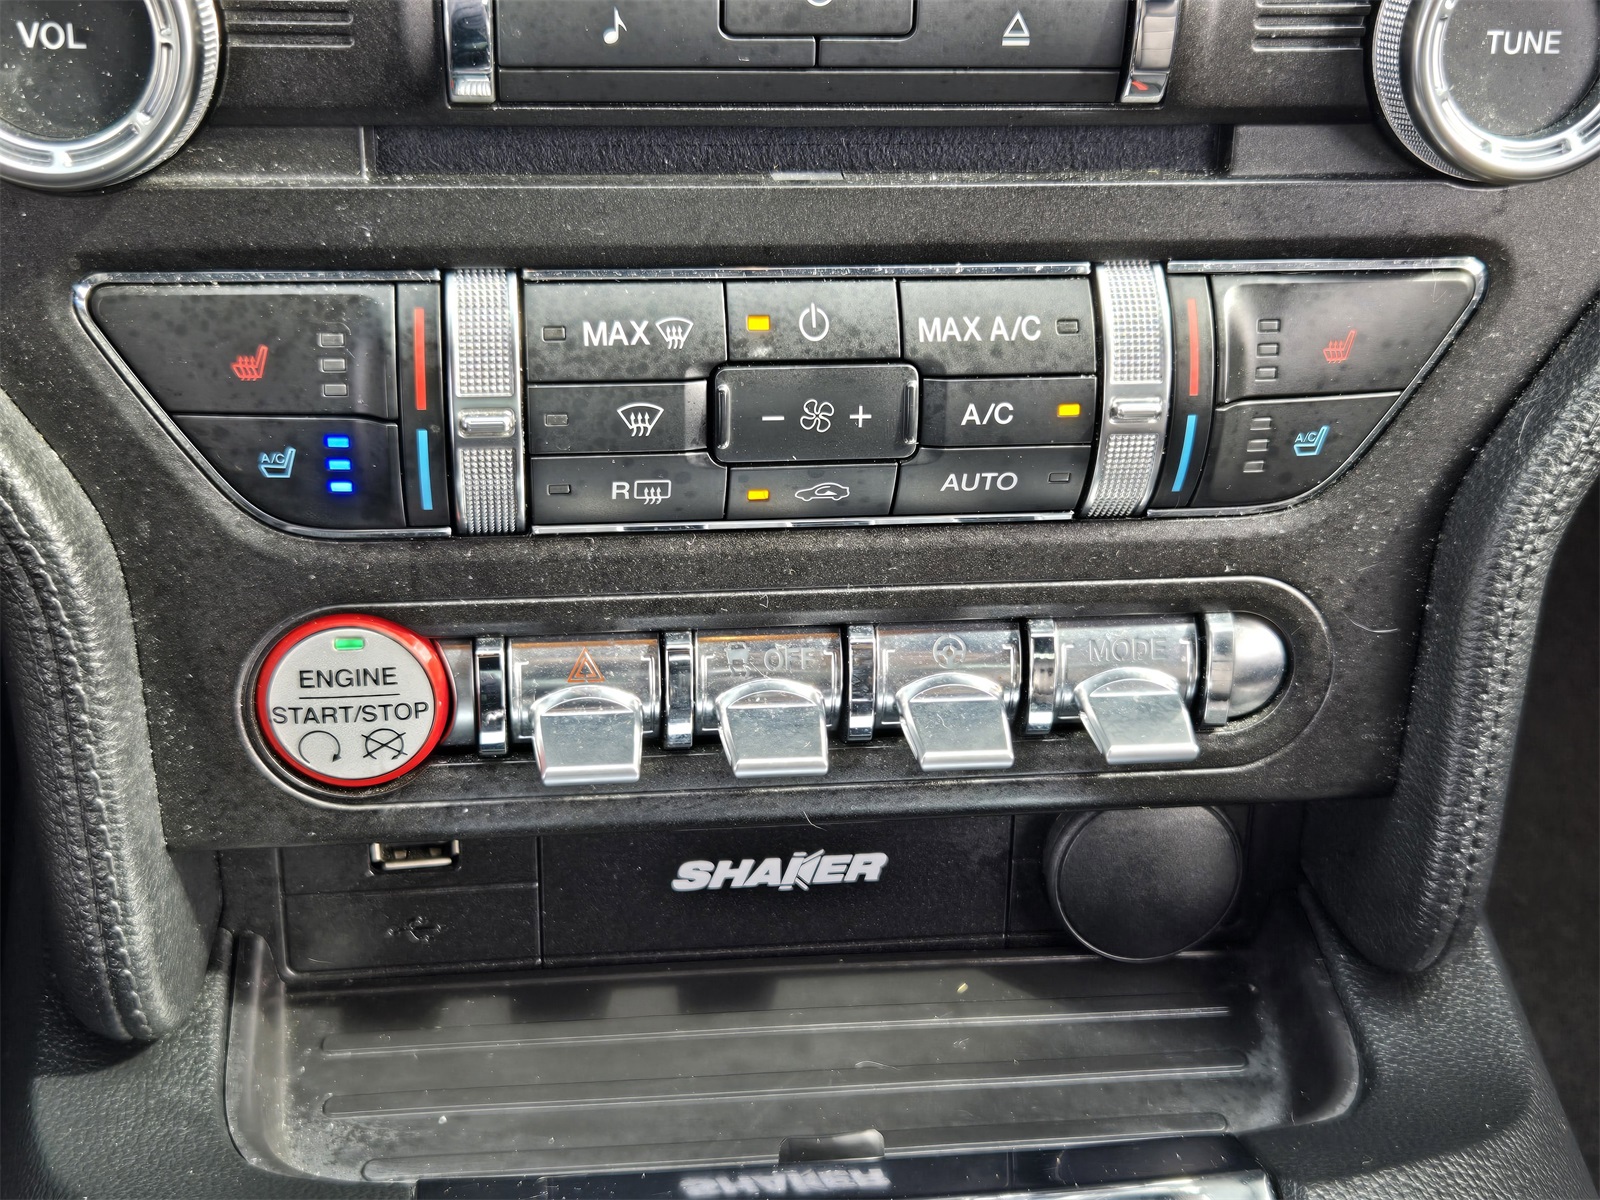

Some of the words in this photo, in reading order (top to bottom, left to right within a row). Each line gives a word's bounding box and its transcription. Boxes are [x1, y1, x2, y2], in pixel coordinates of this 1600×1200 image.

[17, 22, 86, 50] VOL
[1487, 30, 1561, 55] TUNE
[582, 321, 650, 346] MAX
[918, 316, 982, 342] MAX
[989, 315, 1042, 341] A/C
[960, 403, 1014, 425] A/C
[1295, 432, 1318, 443] A/C
[261, 453, 286, 464] A/C
[611, 481, 630, 500] R
[939, 472, 1018, 492] AUTO
[763, 647, 815, 671] OFF
[1088, 637, 1168, 663] MODE
[299, 666, 397, 689] ENGINE
[271, 701, 429, 725] START/STOP
[671, 850, 888, 892] SHAKER
